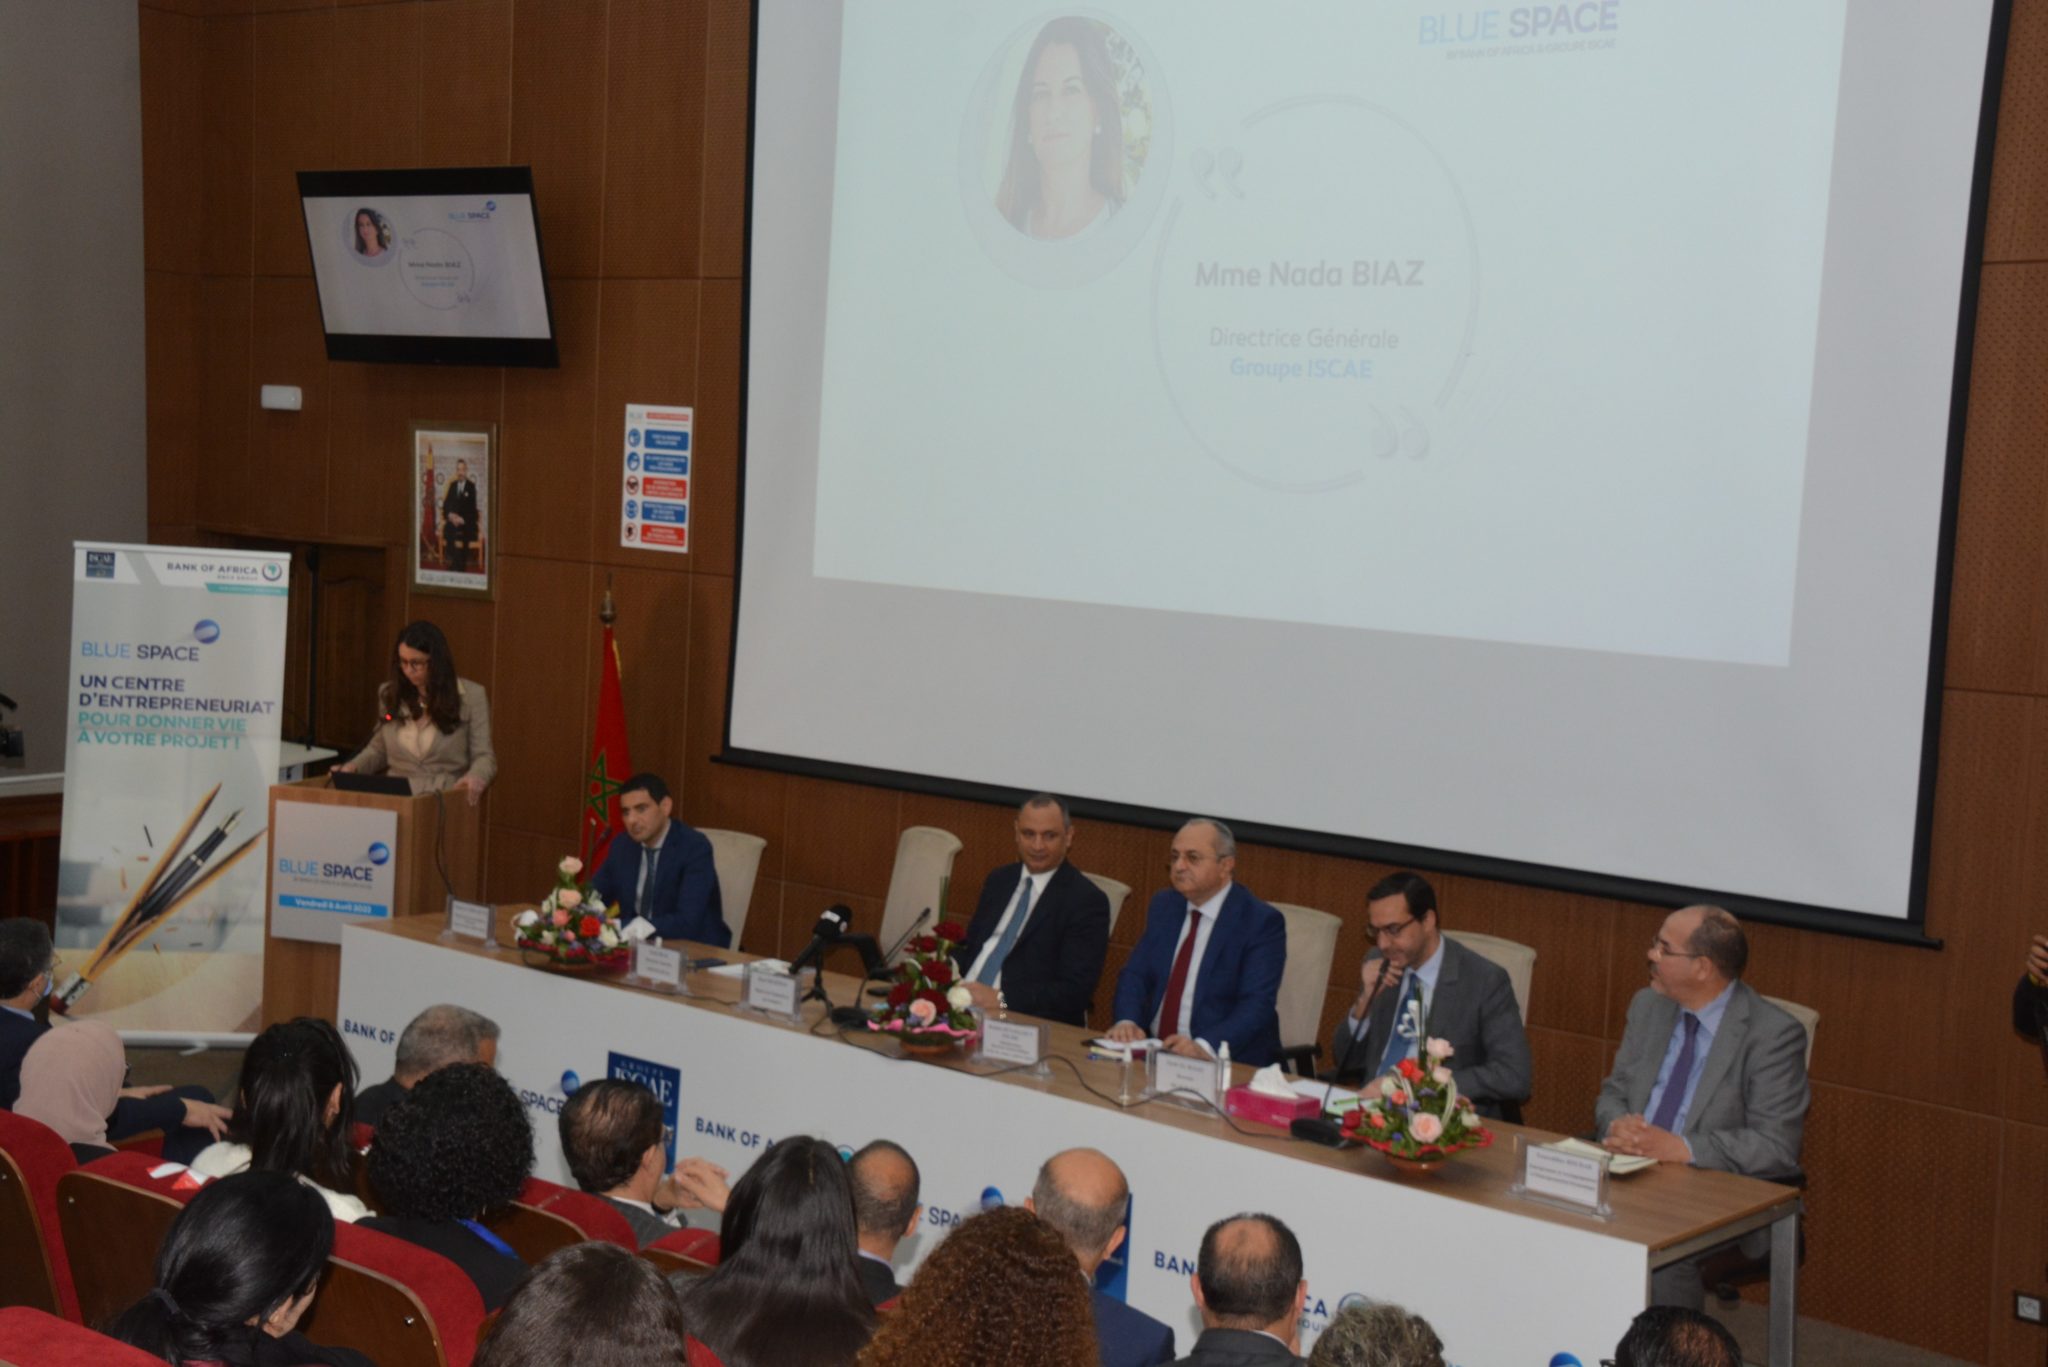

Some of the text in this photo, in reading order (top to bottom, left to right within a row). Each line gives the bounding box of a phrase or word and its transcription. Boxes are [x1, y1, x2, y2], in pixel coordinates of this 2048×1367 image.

[1418, 0, 1619, 45] BLUE SPACE
[1195, 259, 1425, 287] Mme Nada BIAZ
[1210, 326, 1400, 349] Directrice Générale
[1230, 356, 1374, 382] Groupe ISCAE
[167, 562, 258, 576] BANK OF AFRICA
[81, 641, 199, 662] BLUE SPACE
[80, 675, 185, 692] UN CENTRE
[79, 692, 275, 715] D'ENTREPRENEURIAT
[78, 711, 247, 732] POUR DONNER VIE
[77, 727, 91, 744] À
[94, 730, 156, 746] VOTRE
[160, 733, 228, 750] PROJET
[279, 858, 373, 881] BLUE SPACE
[344, 1018, 396, 1044] BANK OF
[521, 1089, 564, 1115] SPACE
[695, 1116, 736, 1142] BANK
[740, 1130, 760, 1149] OF
[929, 1205, 961, 1228] SPA
[1154, 1250, 1195, 1276] BAN
